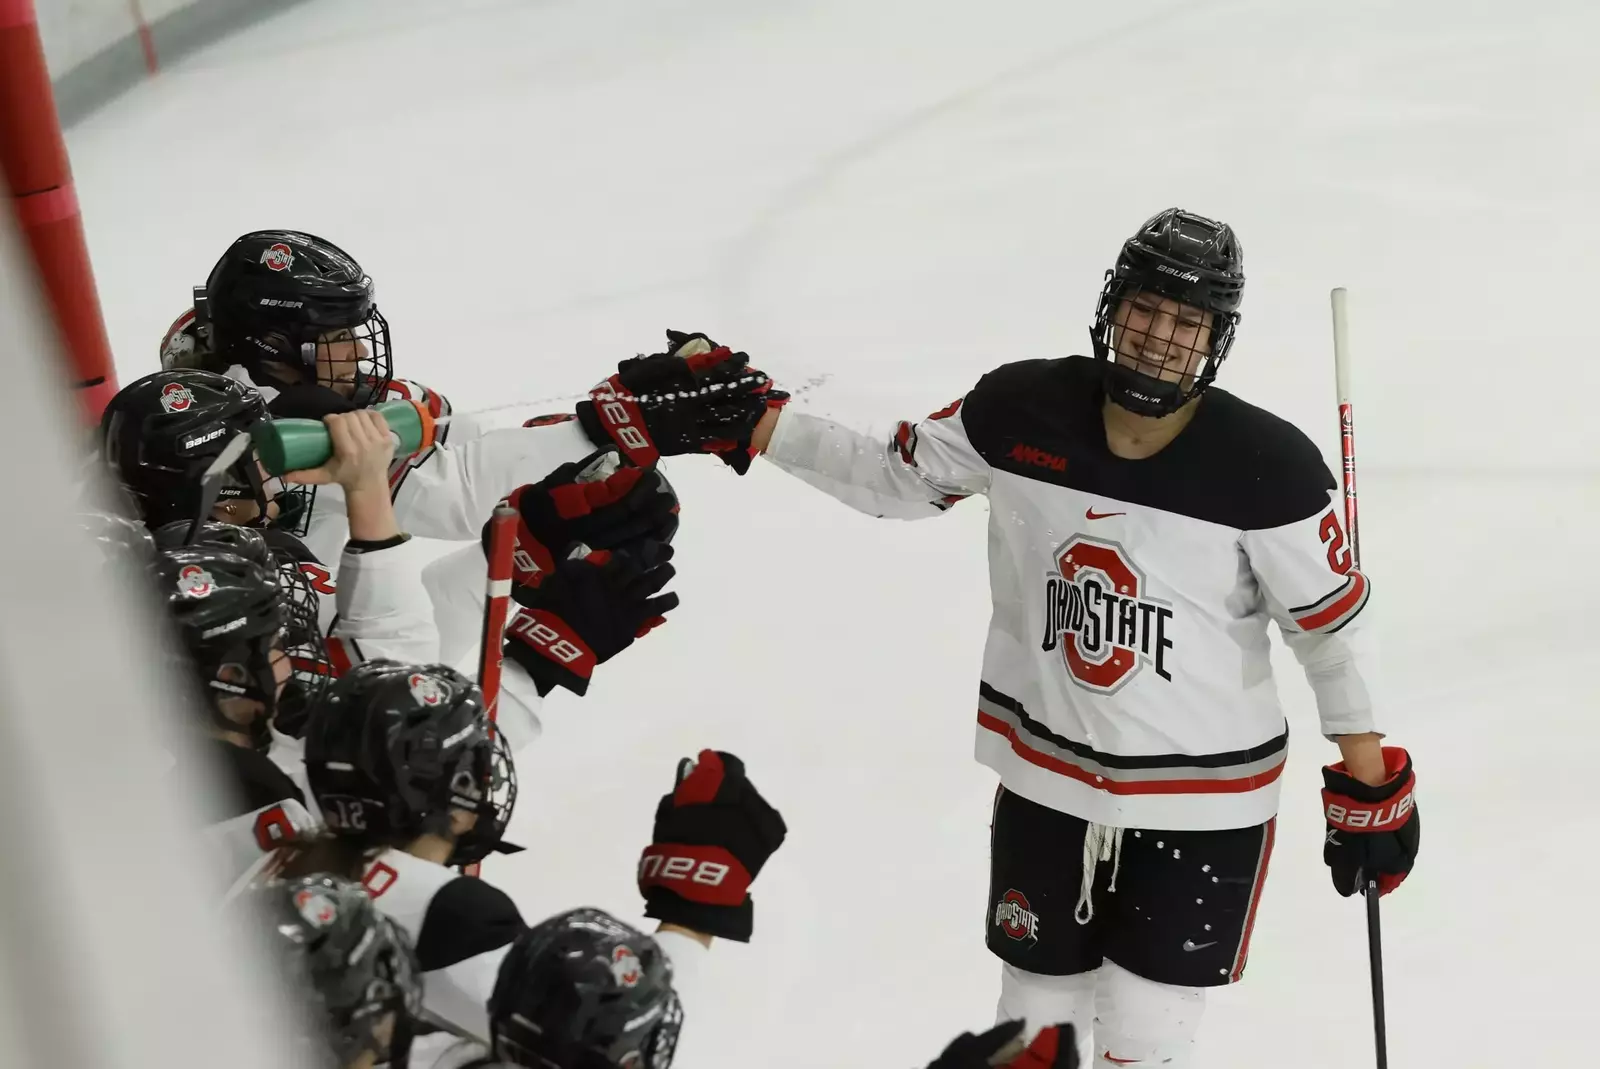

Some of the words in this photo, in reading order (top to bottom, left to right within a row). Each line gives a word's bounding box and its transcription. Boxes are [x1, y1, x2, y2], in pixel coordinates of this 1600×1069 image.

[1156, 264, 1200, 284] BAUER
[260, 298, 304, 309] BAUER
[245, 336, 279, 355] AUER
[185, 427, 227, 450] BAUER
[1041, 578, 1085, 653] OHIO
[1082, 578, 1174, 684] STATE
